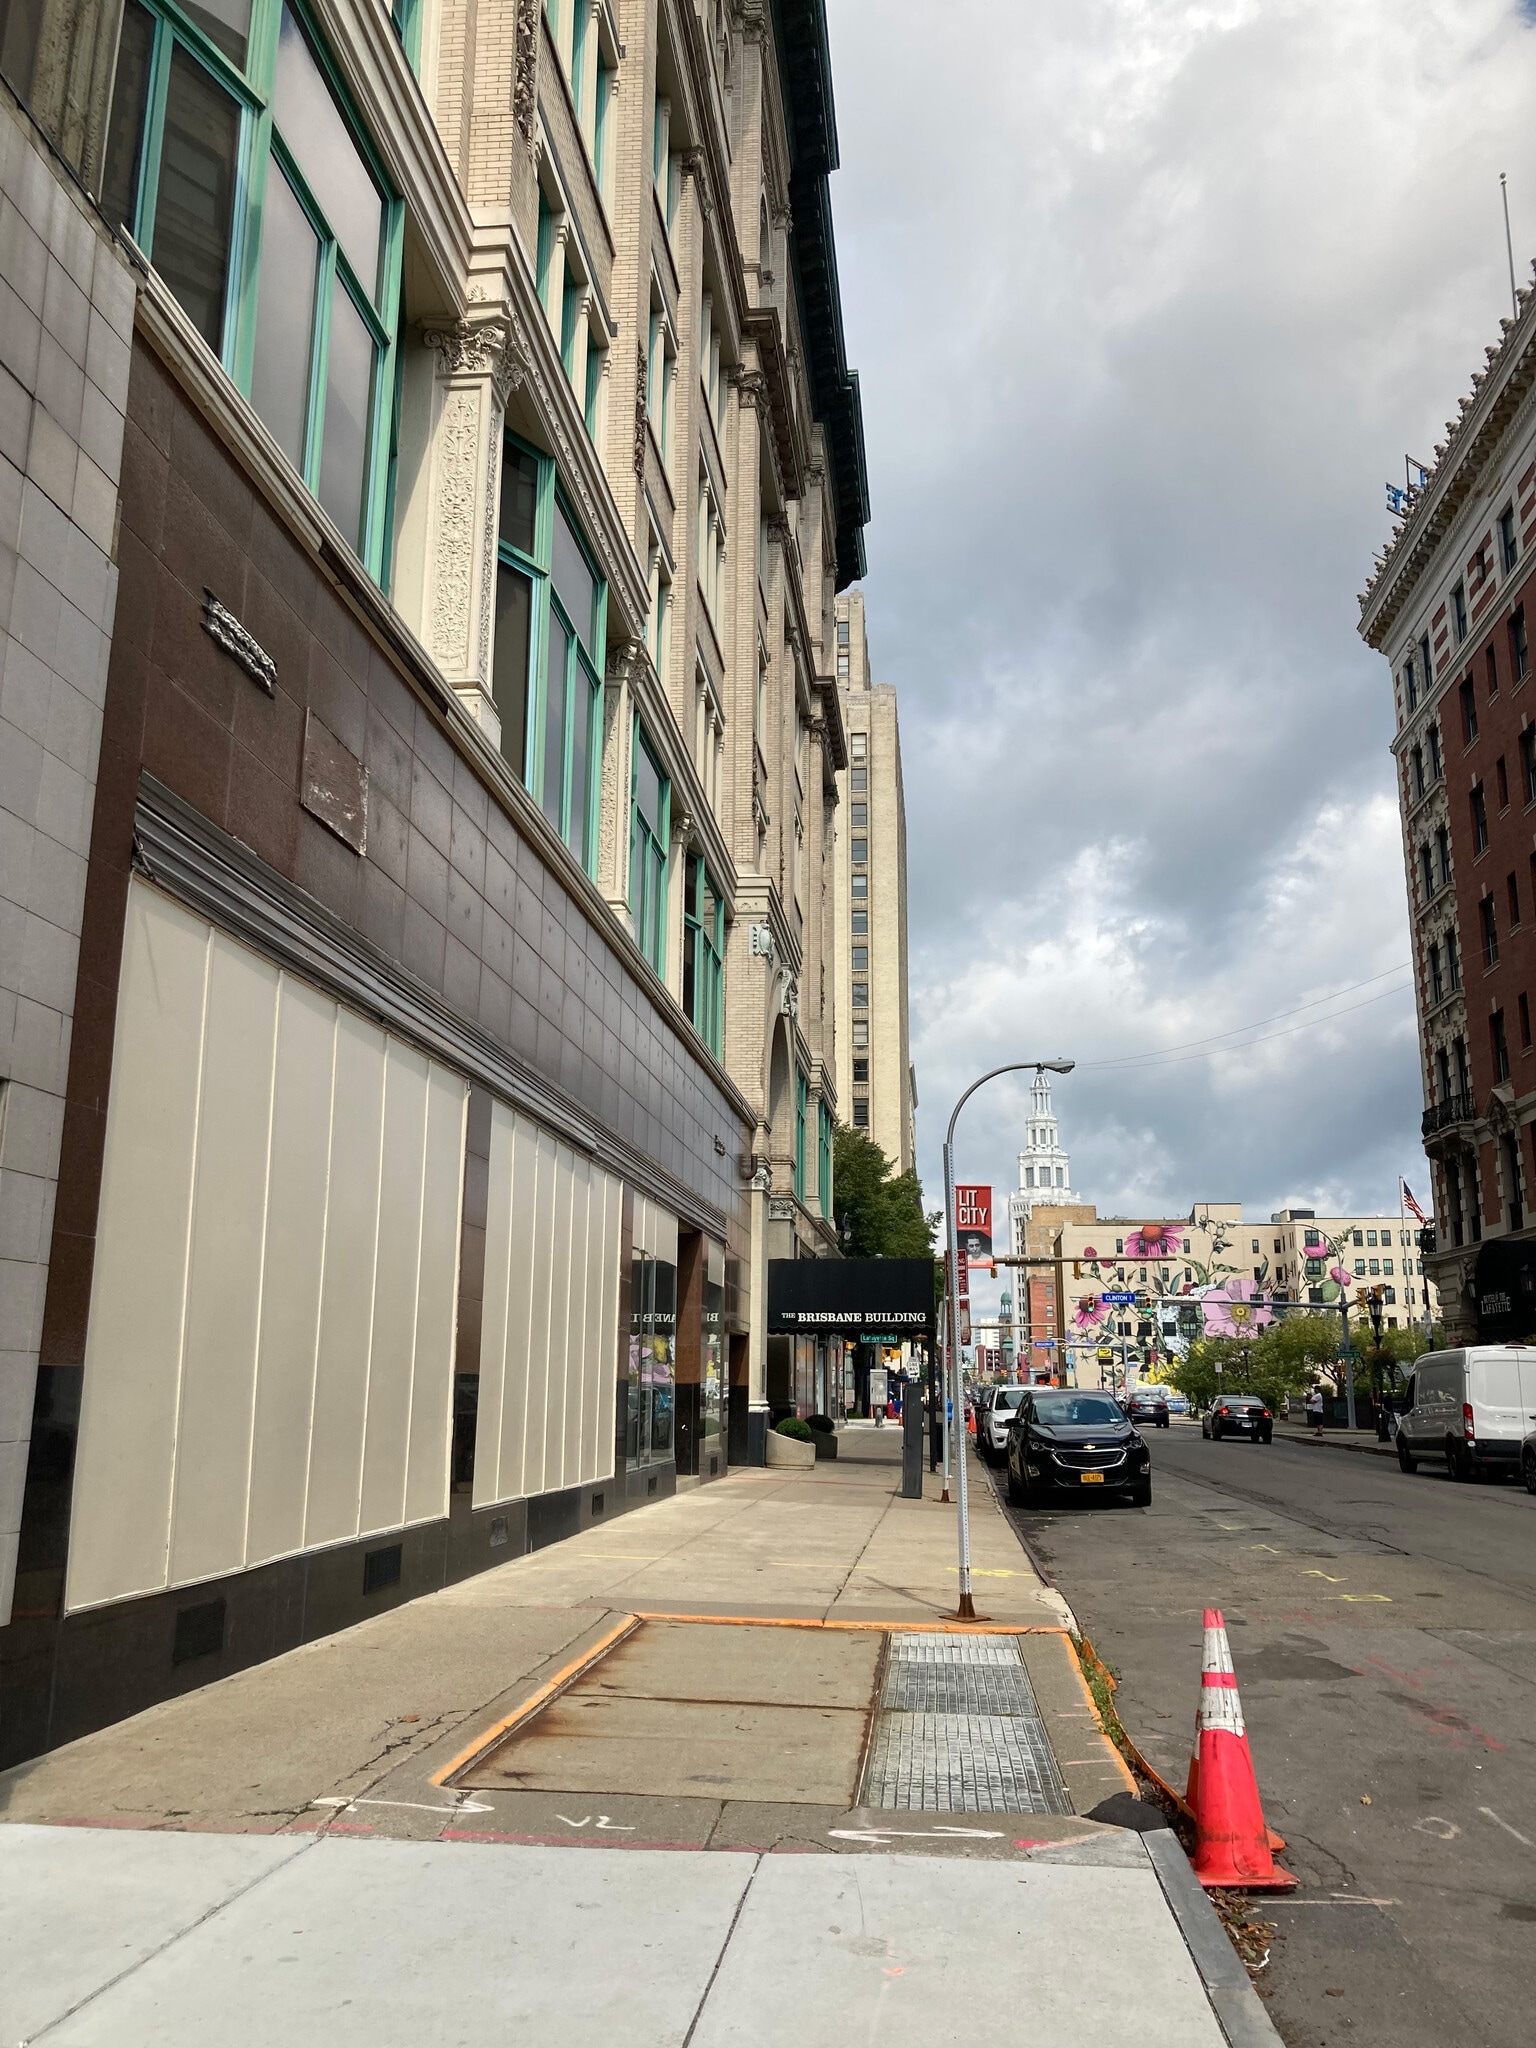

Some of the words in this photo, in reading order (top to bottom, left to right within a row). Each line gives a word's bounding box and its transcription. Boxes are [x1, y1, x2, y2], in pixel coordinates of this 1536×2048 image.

[958, 1189, 978, 1207] LIT
[958, 1207, 988, 1225] CITY
[797, 1312, 862, 1323] BRISBANE
[865, 1312, 927, 1323] BUILDING
